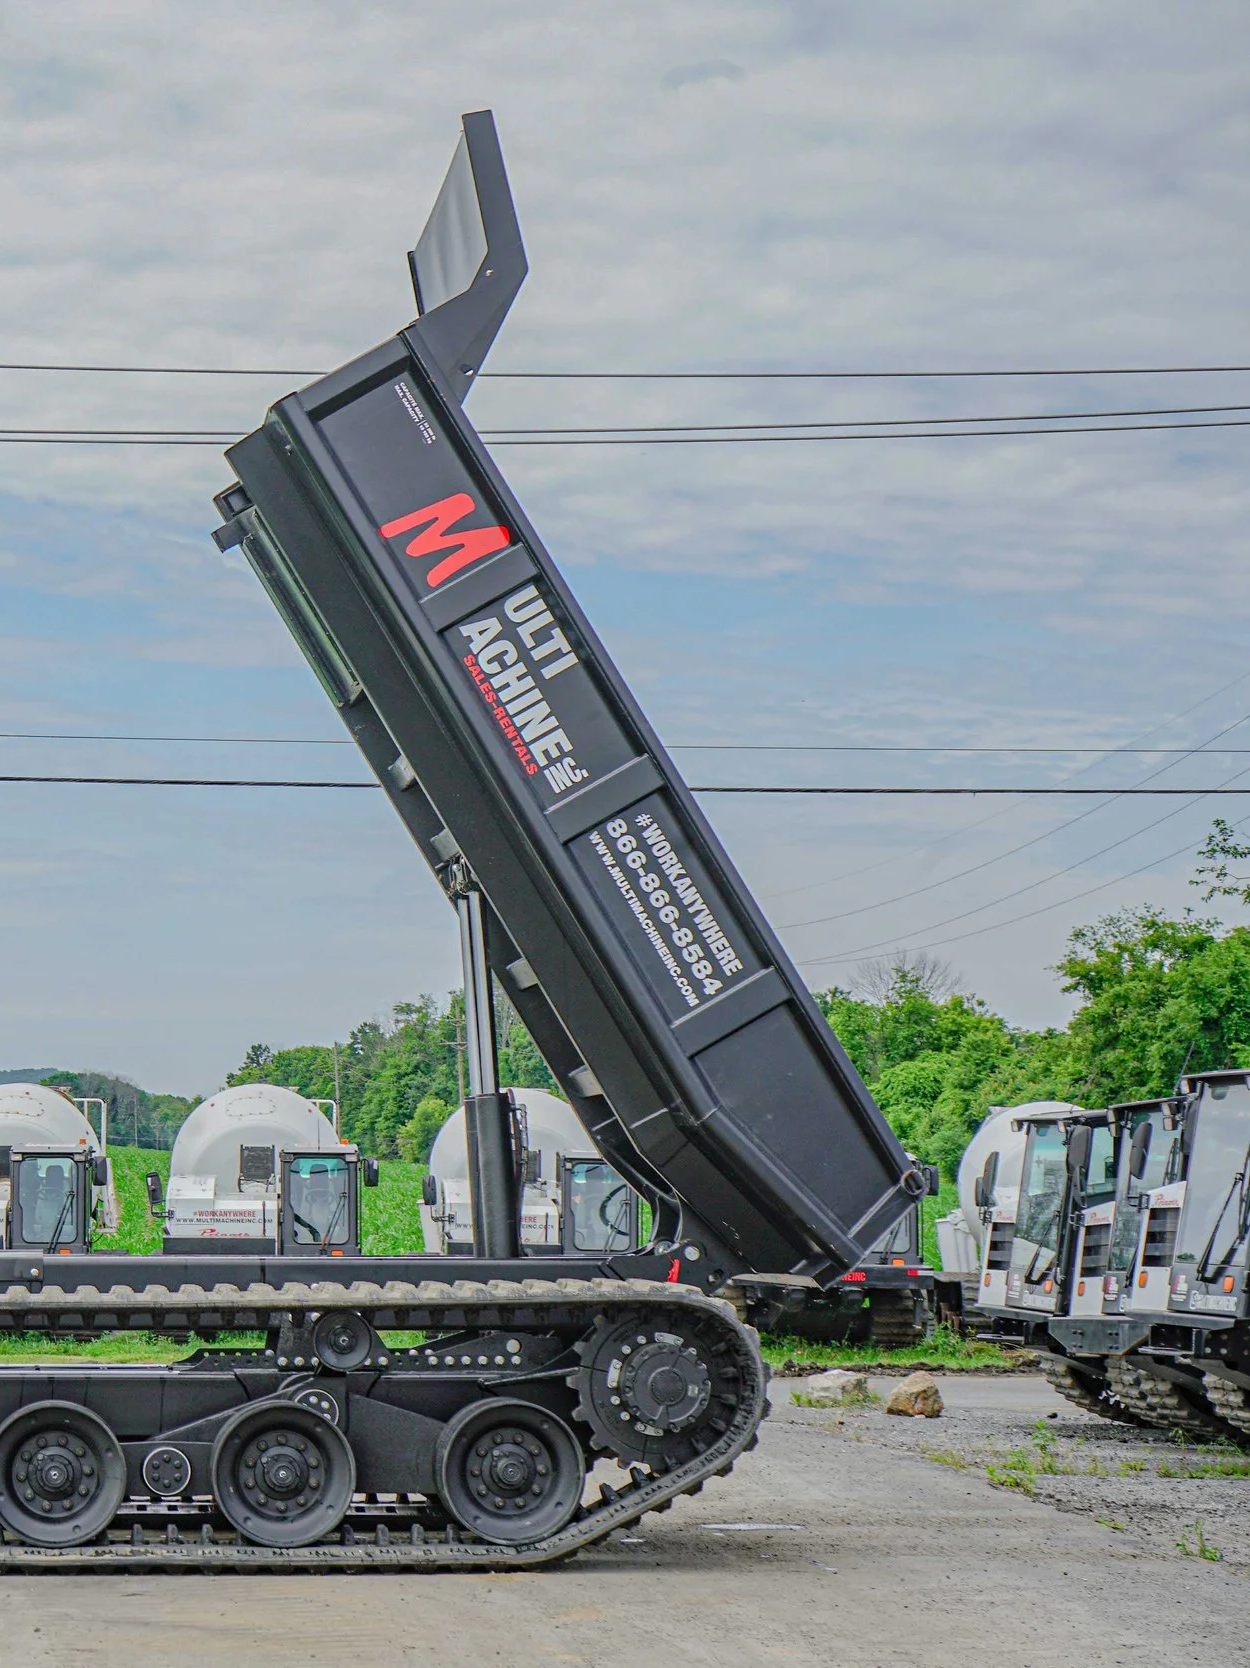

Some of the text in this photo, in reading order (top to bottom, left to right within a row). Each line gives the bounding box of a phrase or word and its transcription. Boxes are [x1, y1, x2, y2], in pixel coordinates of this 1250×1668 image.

[394, 384, 404, 399] MAX.
[402, 397, 420, 423] CAPACITY
[399, 382, 418, 407] CAPACITÉ
[380, 492, 510, 588] M
[503, 584, 580, 680] ULTI
[458, 616, 591, 794] ACHINE INC.
[462, 653, 539, 776] SALES-RENTALS
[588, 830, 700, 1008] WWW.MULTIMACHINEINC.COM
[606, 818, 724, 996] 866-866-8584
[634, 813, 744, 977] #WORKANYWHERE
